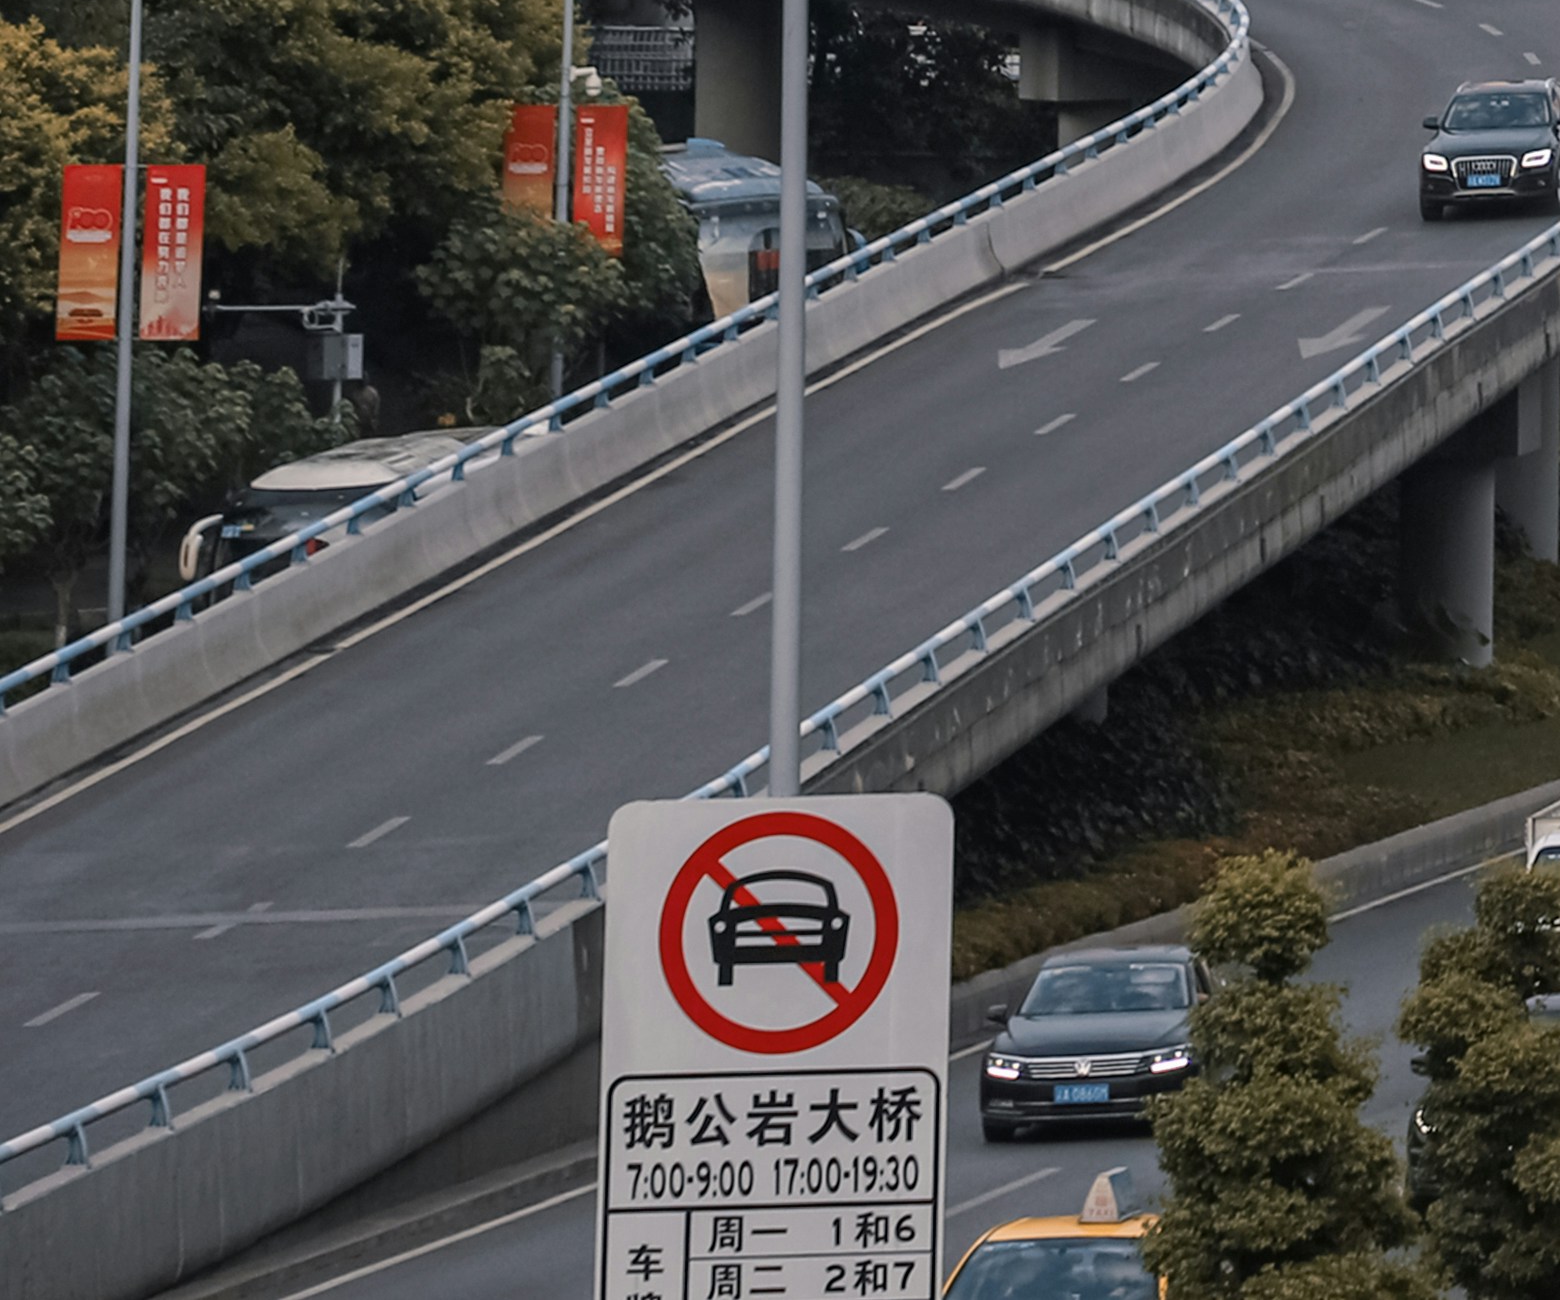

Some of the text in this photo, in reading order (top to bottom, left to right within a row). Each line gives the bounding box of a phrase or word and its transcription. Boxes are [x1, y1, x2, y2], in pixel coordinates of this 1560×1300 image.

[623, 1085, 921, 1150] 鹅公岩大桥
[627, 1154, 918, 1200] 7:00-9:00 17:00-19:30
[709, 1213, 915, 1253] 周一 1和6
[708, 1260, 915, 1300] 周二 2和7
